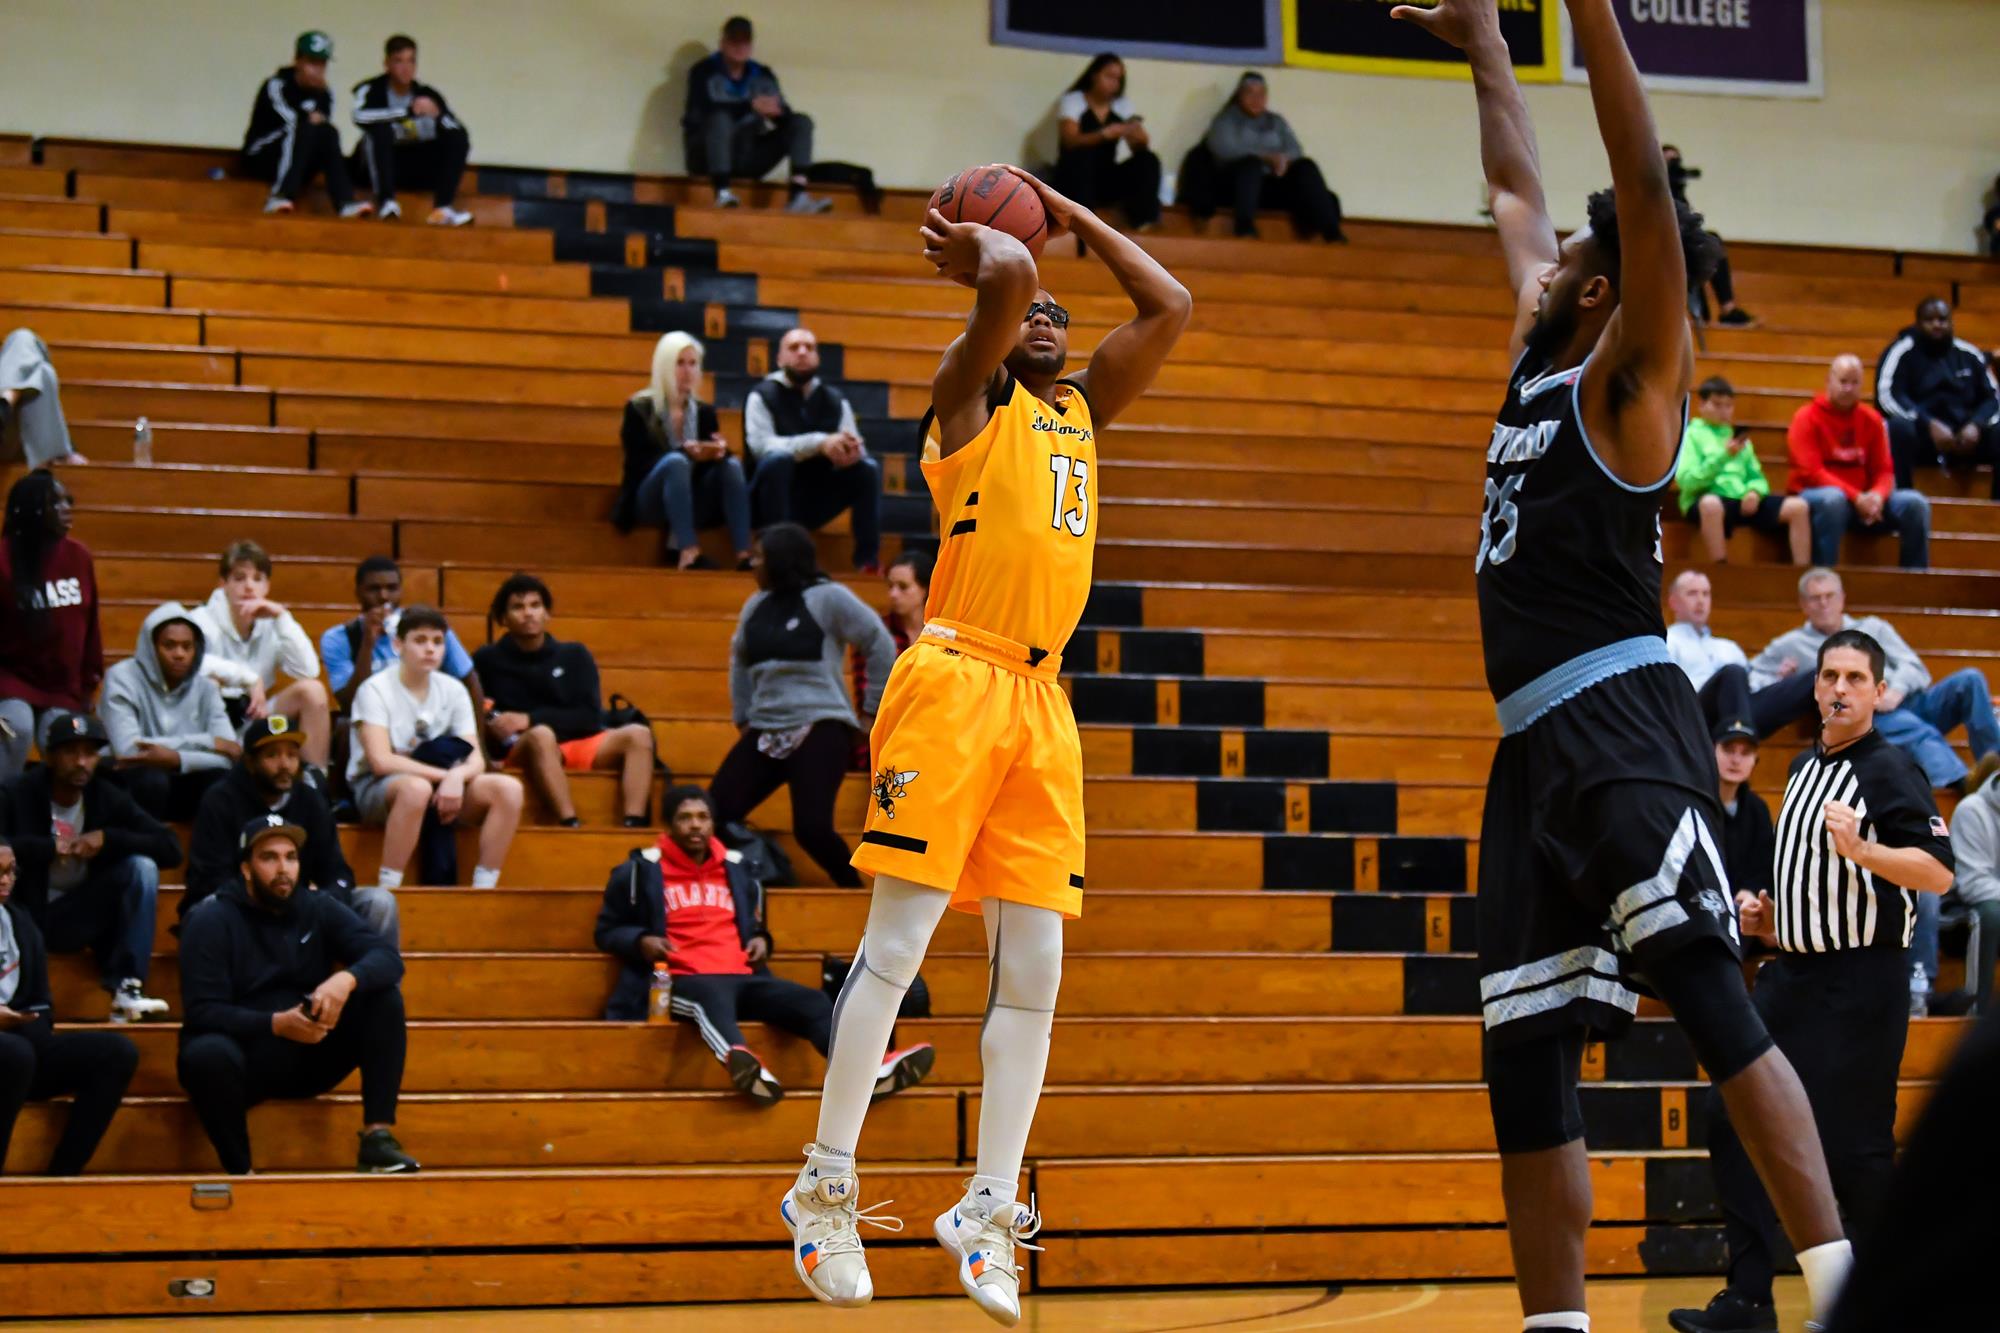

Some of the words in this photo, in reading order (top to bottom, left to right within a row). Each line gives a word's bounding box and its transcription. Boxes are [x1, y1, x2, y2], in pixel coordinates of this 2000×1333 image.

[1630, 0, 1750, 28] COLLEGE
[1050, 454, 1089, 537] 13
[1226, 752, 1239, 768] H
[1432, 916, 1443, 938] E
[817, 1141, 830, 1153] PRO
